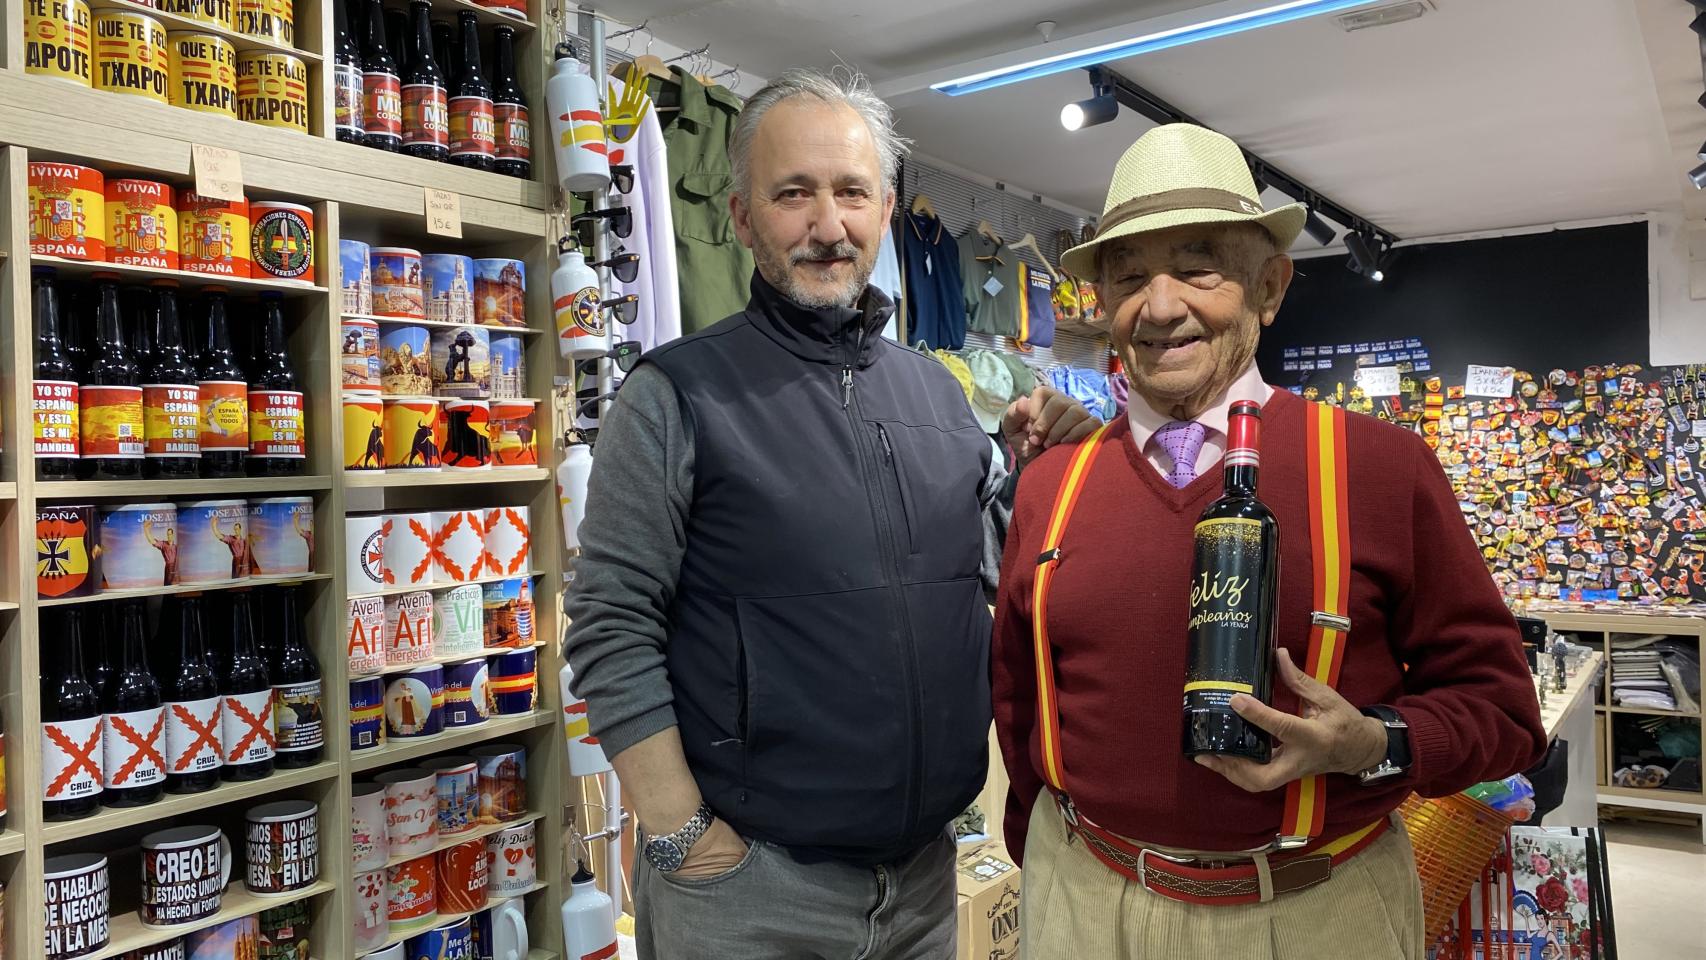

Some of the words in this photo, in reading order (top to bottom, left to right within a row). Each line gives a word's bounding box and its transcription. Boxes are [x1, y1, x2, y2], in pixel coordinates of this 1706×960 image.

[97, 20, 124, 38] QUE
[128, 22, 145, 41] TE
[180, 41, 206, 58] QUE
[210, 44, 224, 62] TE
[237, 60, 253, 78] QUE
[257, 60, 272, 76] TE
[377, 95, 401, 113] MI
[237, 97, 307, 129] TXAPOTE
[31, 165, 79, 180] ¡VIVA!
[117, 182, 161, 196] ¡VIVA!
[30, 243, 87, 256] ESPAÑA
[114, 255, 168, 269] ESPAÑA
[183, 263, 234, 274] ESPAÑA
[37, 385, 51, 397] YO
[54, 386, 72, 398] SOY
[167, 389, 180, 399] YO
[268, 395, 281, 405] YO
[283, 396, 298, 406] SOY
[39, 413, 46, 424] Y
[169, 416, 176, 425] Y
[270, 419, 277, 429] Y
[42, 428, 56, 438] ES
[58, 428, 70, 438] MI
[172, 428, 184, 439] ES
[273, 432, 284, 441] ES
[286, 432, 296, 441] MI
[138, 513, 164, 523] JOSE
[204, 508, 229, 519] JOSE
[351, 600, 384, 616] Avent
[249, 746, 268, 757] CRUZ
[196, 755, 216, 766] CRUZ
[135, 768, 156, 779] CRUZ
[70, 780, 93, 791] CRUZ
[386, 812, 411, 827] San
[283, 823, 298, 842] NO
[283, 842, 298, 862] DE
[155, 847, 203, 884] CREO
[207, 840, 221, 875] EN
[283, 861, 299, 886] EN
[302, 858, 314, 882] LA
[156, 883, 197, 903] ESTADOS
[156, 907, 165, 920] HA
[166, 902, 191, 918] HECHO
[192, 902, 201, 915] MI
[65, 924, 85, 952] LA
